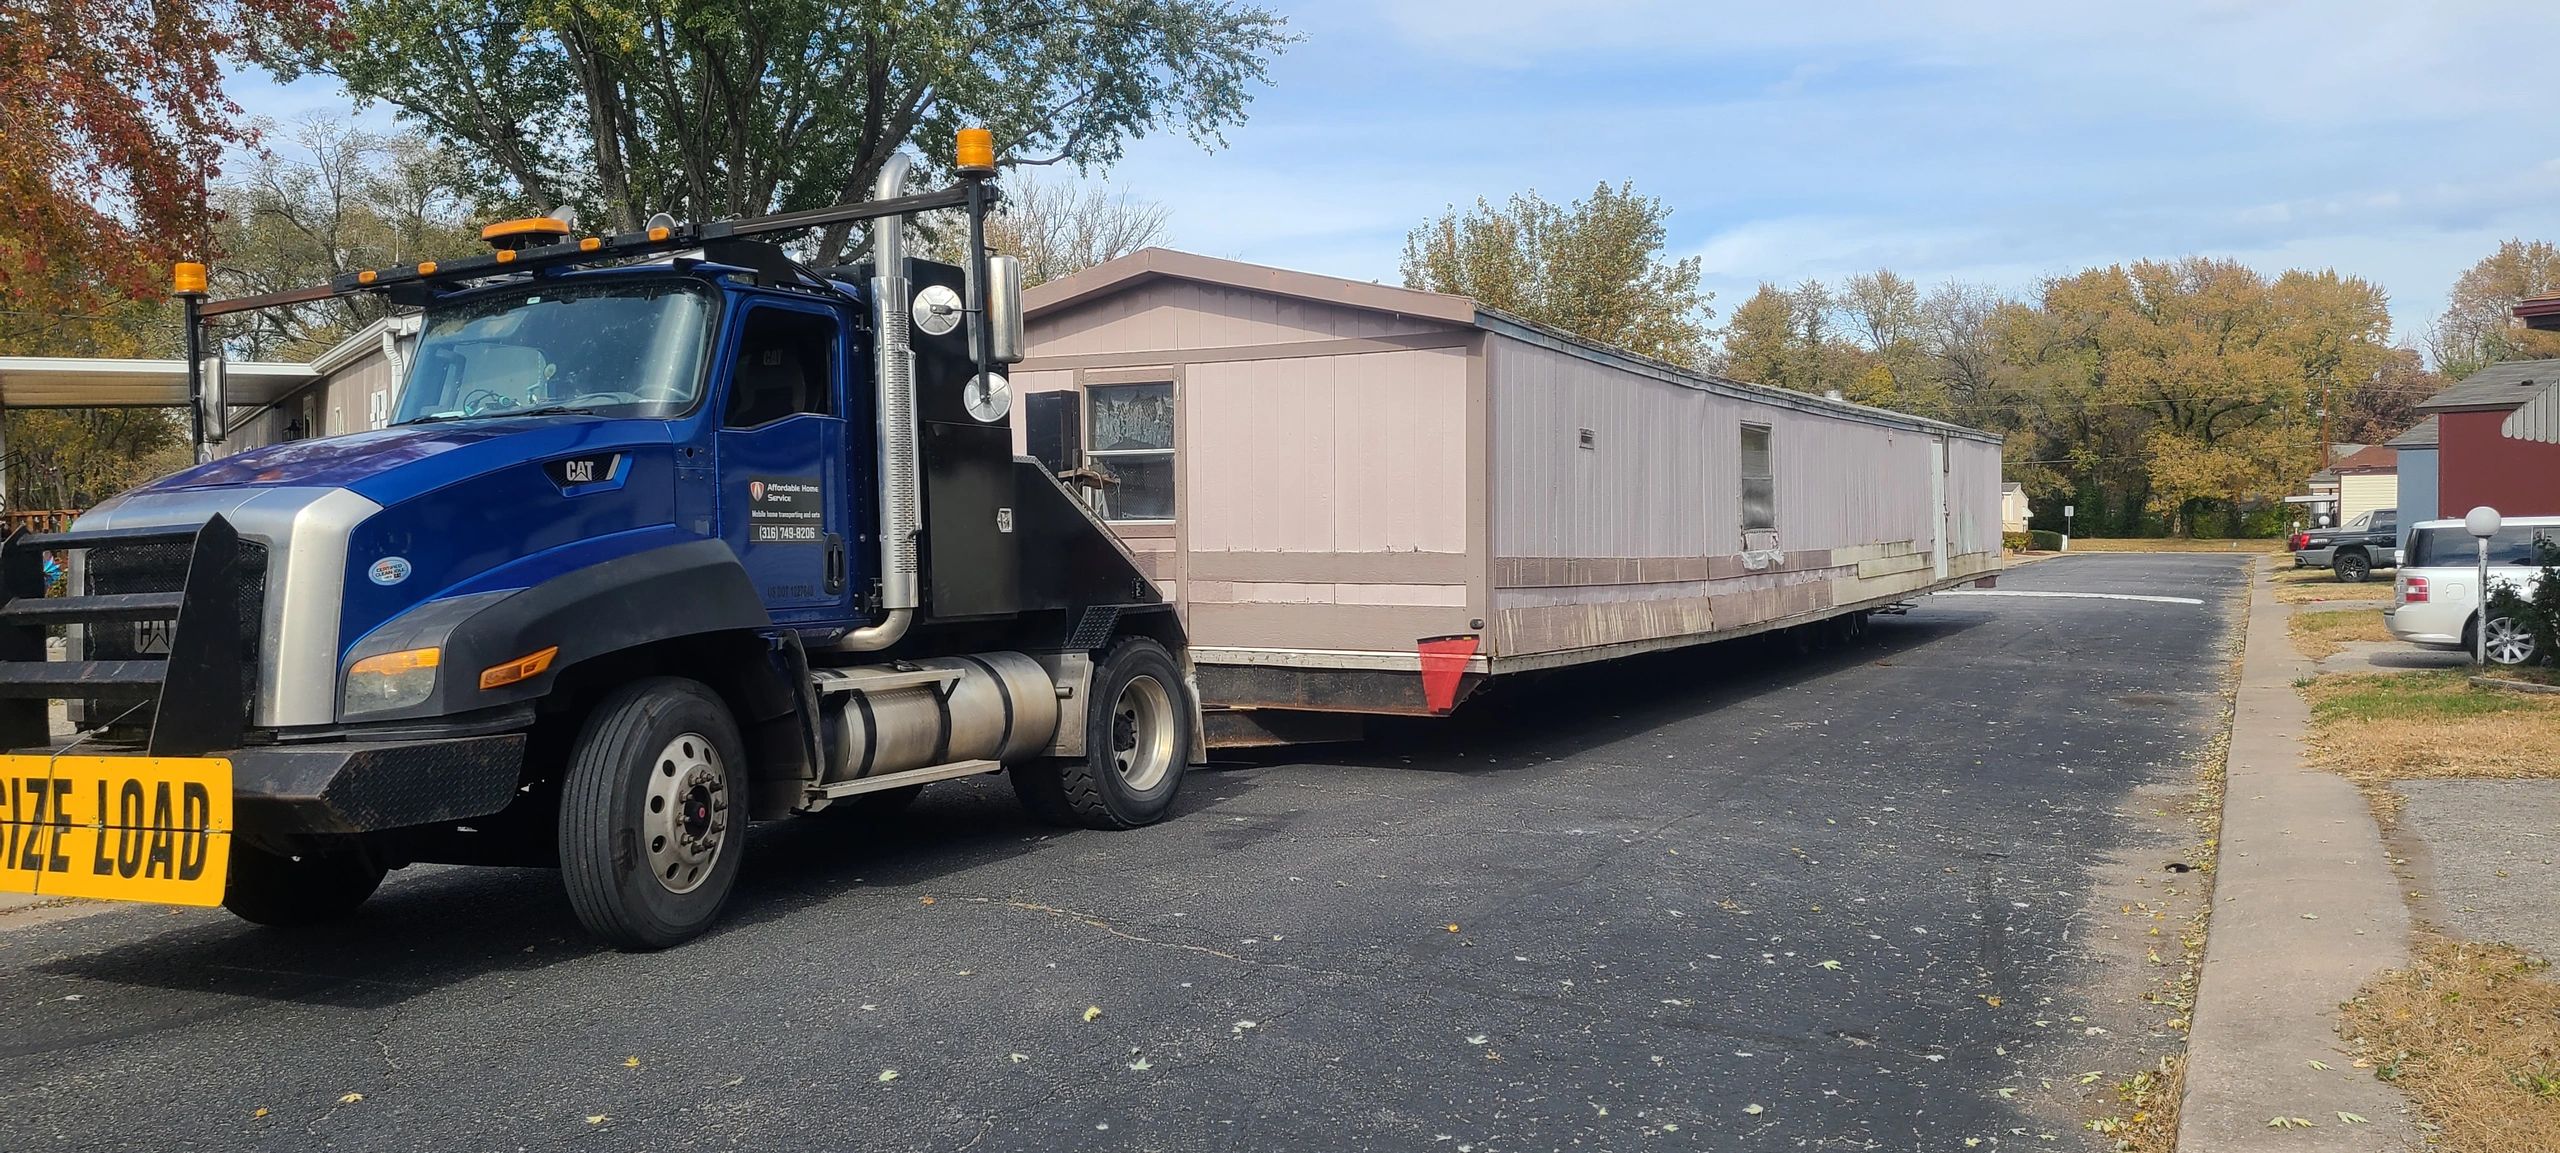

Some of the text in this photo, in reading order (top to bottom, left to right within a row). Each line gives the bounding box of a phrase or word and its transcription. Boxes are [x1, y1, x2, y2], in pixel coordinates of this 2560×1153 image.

[566, 461, 594, 481] CAT
[767, 483, 819, 493] Affordable Home
[767, 494, 792, 502] Service
[751, 509, 766, 518] Mobile
[766, 510, 778, 518] home
[778, 511, 803, 519] transporting
[759, 525, 779, 541] (316)
[0, 777, 211, 881] IZE LOAD
